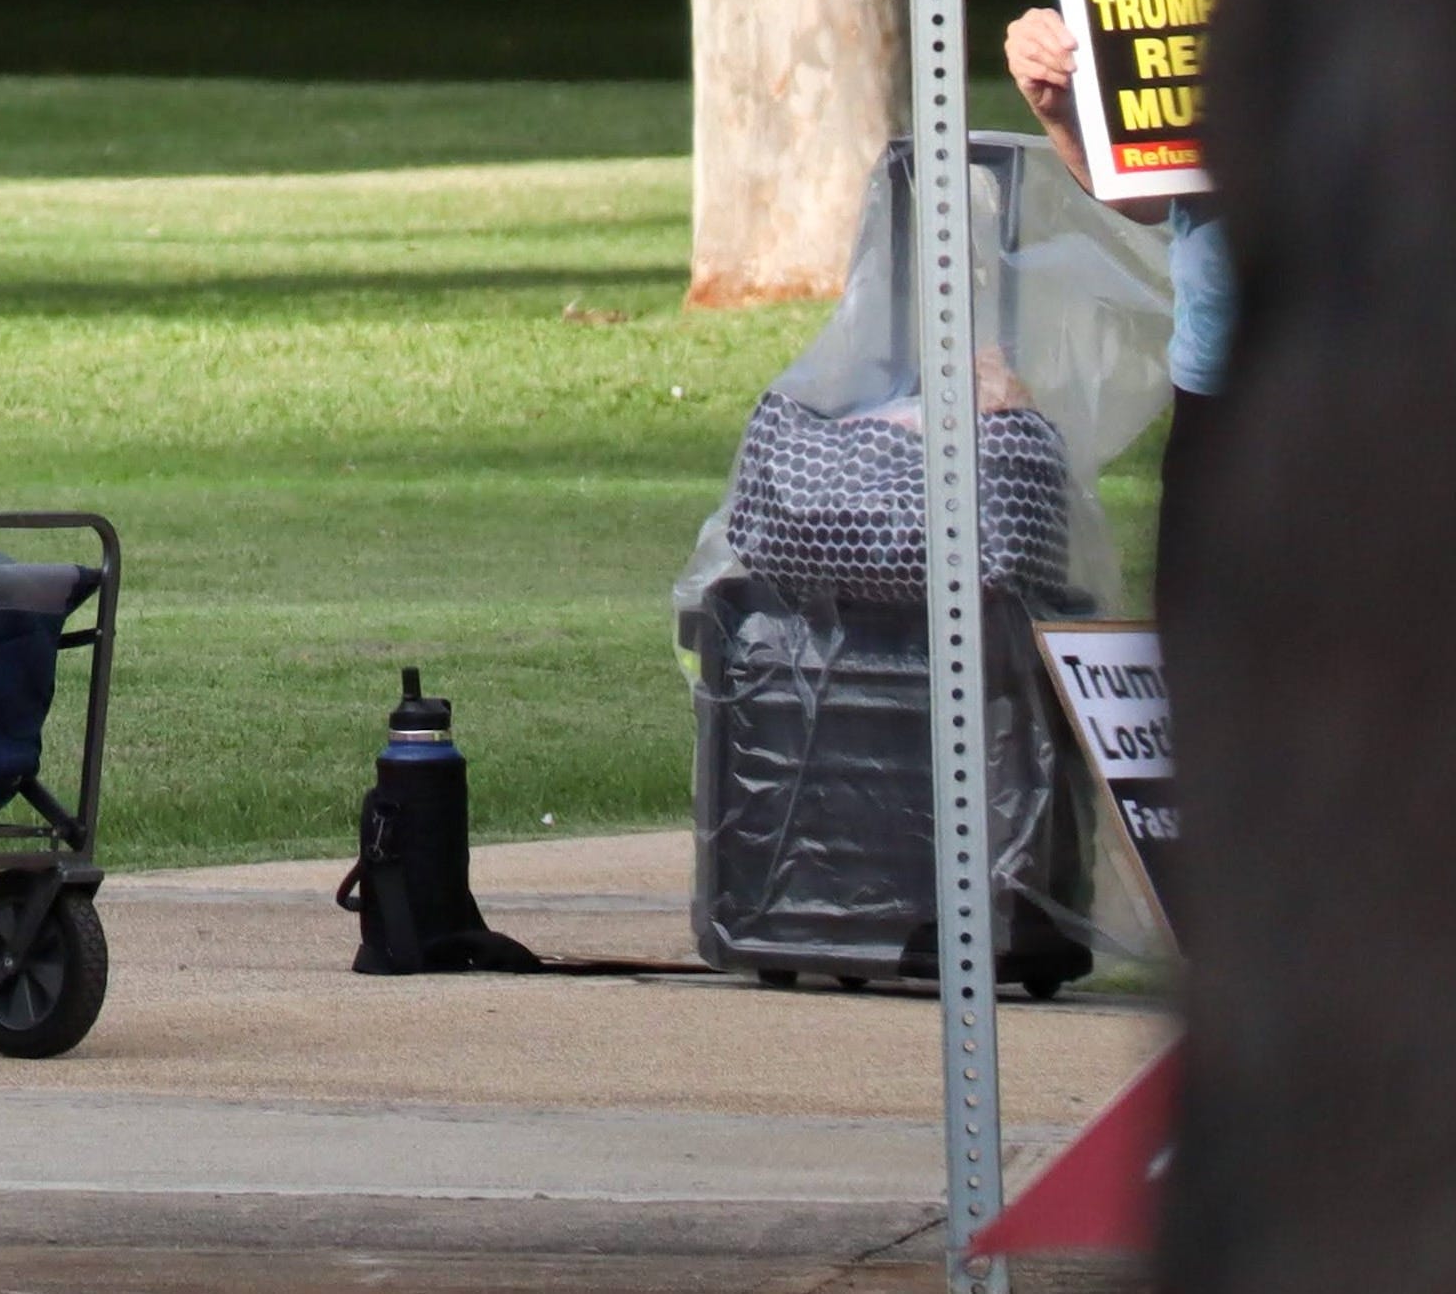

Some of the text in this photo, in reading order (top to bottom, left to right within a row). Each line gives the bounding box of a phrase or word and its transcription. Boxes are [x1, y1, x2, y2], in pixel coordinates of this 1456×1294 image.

[1134, 34, 1206, 80] RE
[1118, 86, 1205, 131] MU
[1121, 146, 1203, 169] Refus
[1061, 655, 1169, 700] Trum
[1122, 798, 1182, 840] Fas
